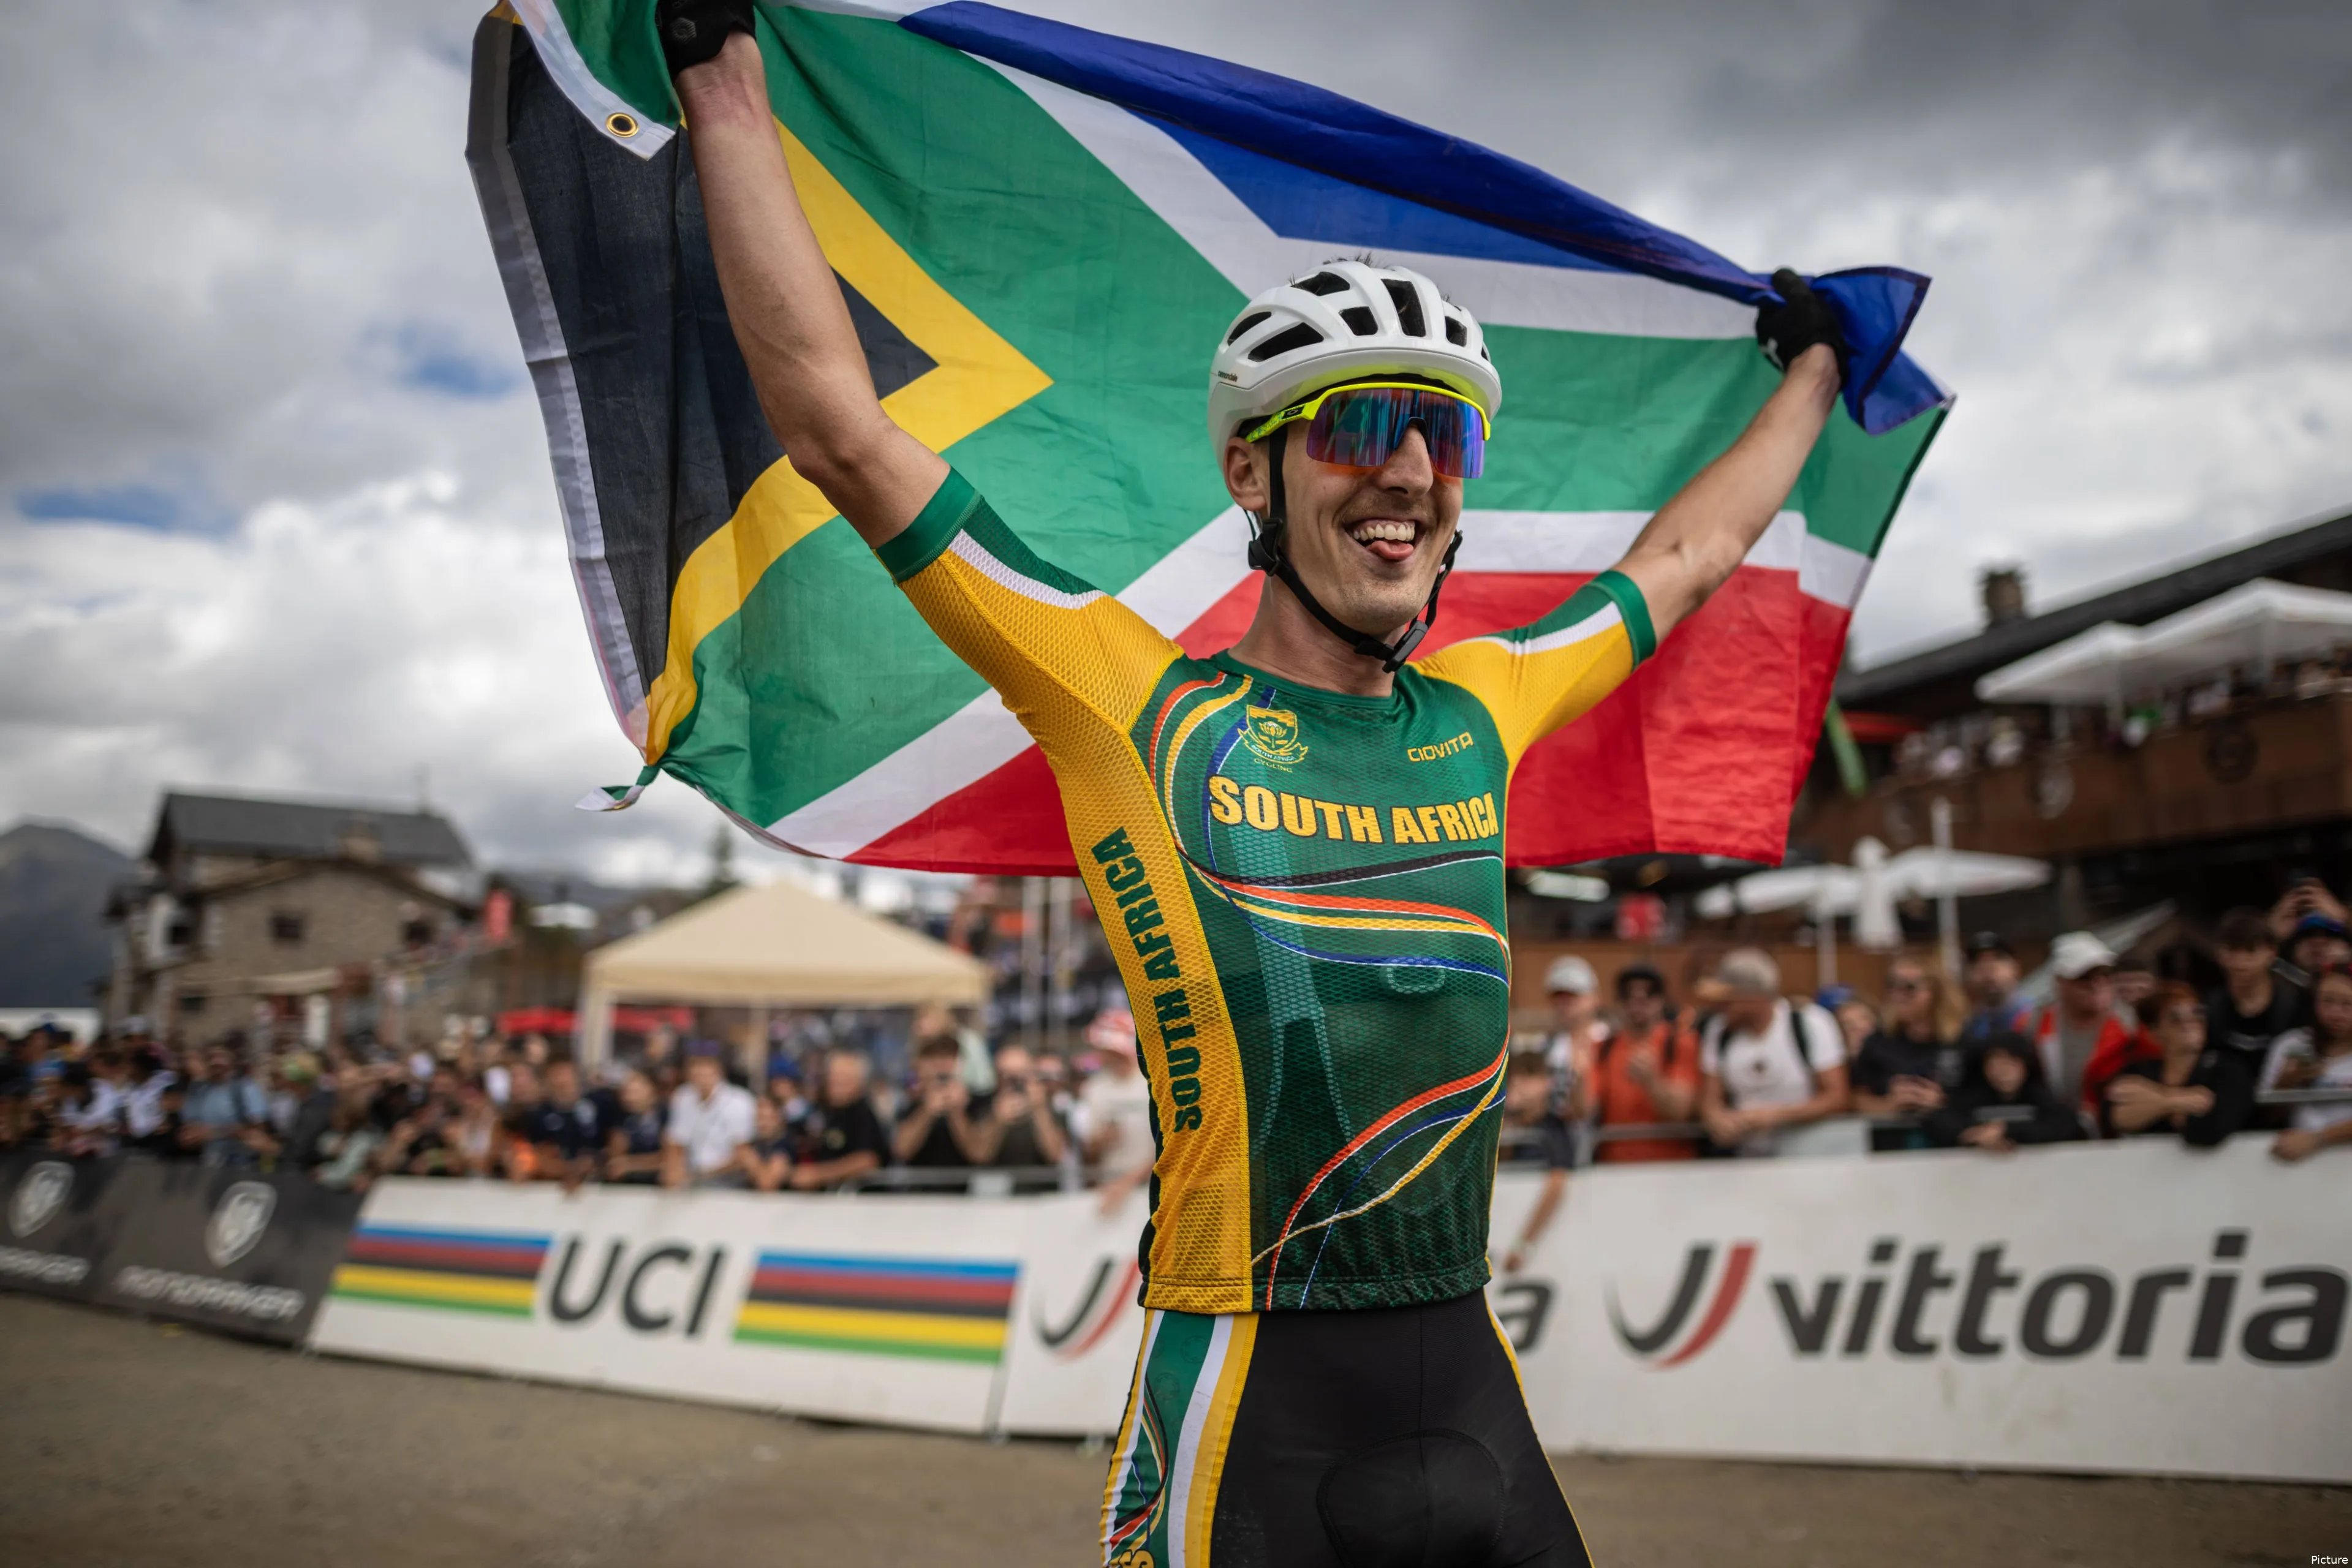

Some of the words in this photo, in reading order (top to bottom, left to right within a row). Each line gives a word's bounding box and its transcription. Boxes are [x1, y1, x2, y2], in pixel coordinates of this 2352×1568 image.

[1250, 744, 1272, 759] SOUTH
[1254, 758, 1293, 773] CYCLING
[1407, 731, 1474, 762] CIOVITA
[1208, 775, 1384, 843] SOUTH
[1391, 791, 1500, 844] AFRICA
[1091, 826, 1181, 981] AFRICA
[1154, 988, 1203, 1133] SOUTH
[549, 1236, 724, 1336] UCI
[1769, 1231, 2351, 1361] vittoria
